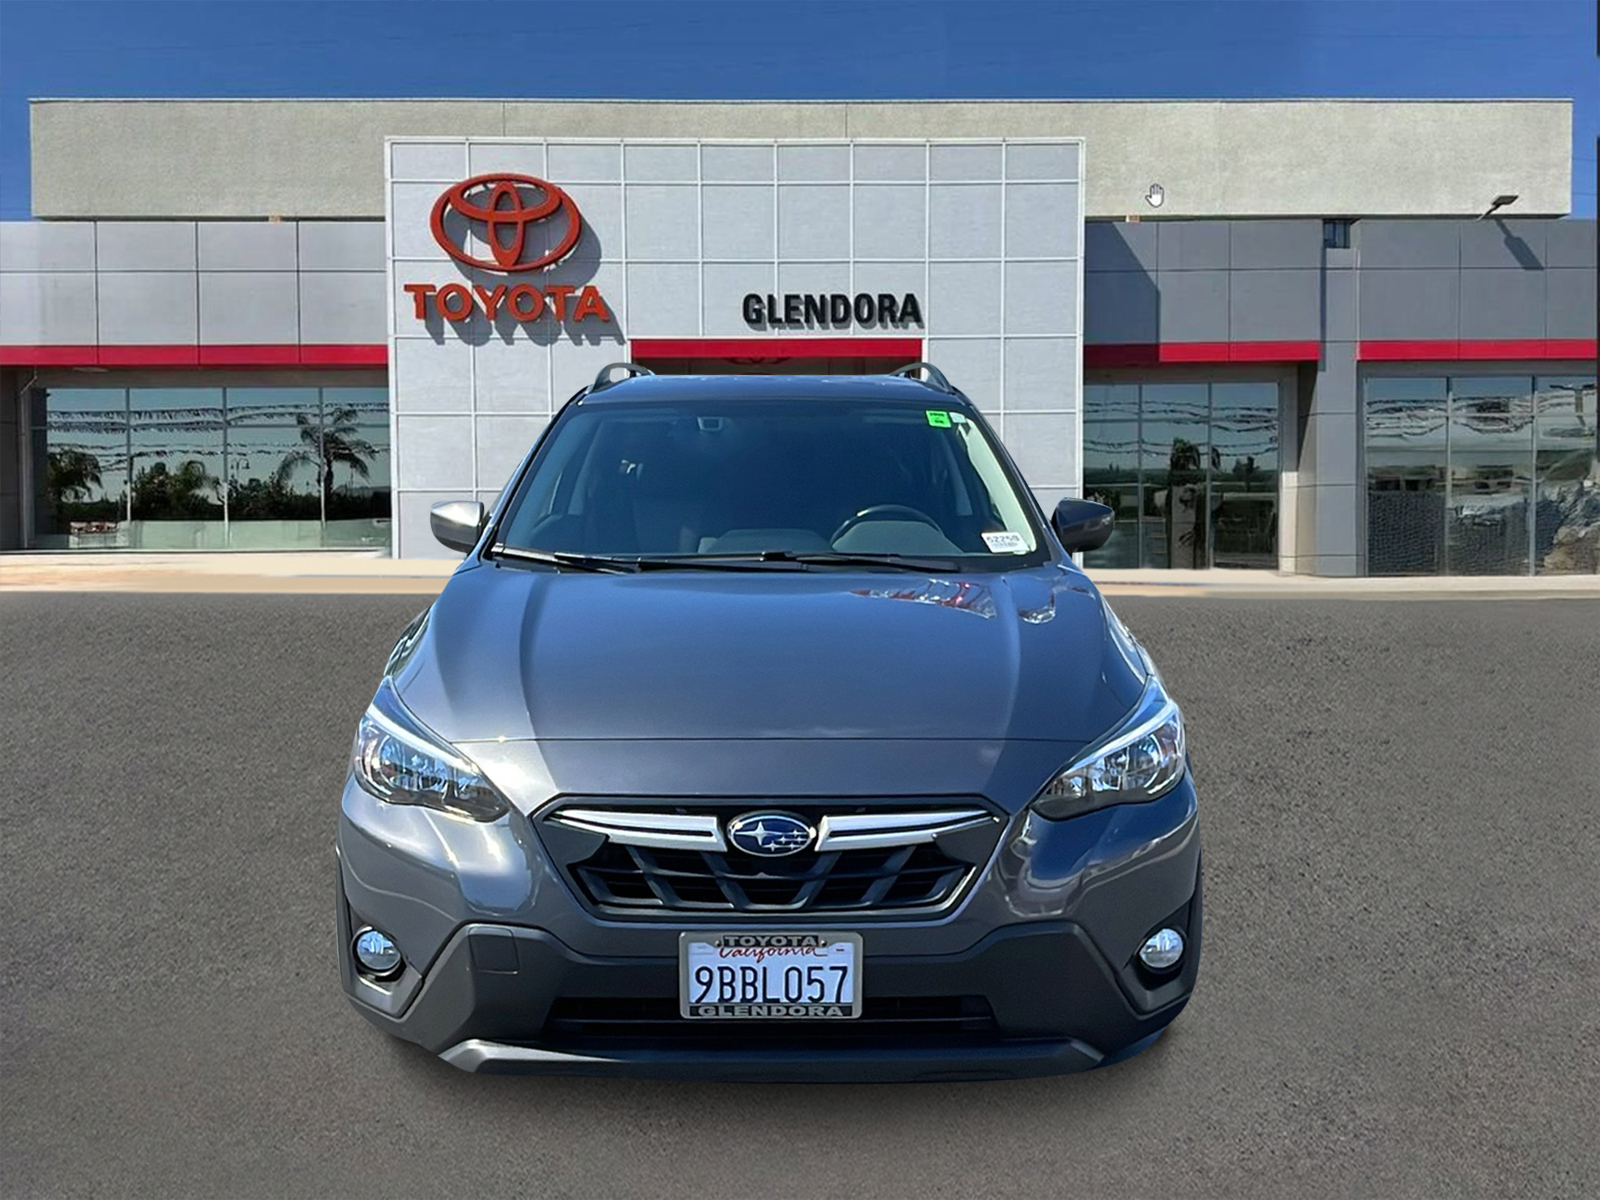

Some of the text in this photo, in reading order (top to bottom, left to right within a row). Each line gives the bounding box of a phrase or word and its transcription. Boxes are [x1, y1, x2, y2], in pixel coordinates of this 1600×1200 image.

[404, 283, 610, 322] TOYOTA
[742, 293, 922, 325] GLENDORA
[724, 936, 817, 947] TOYOTA
[694, 966, 848, 1003] 9BBL057
[698, 1005, 844, 1016] GLENDORA
